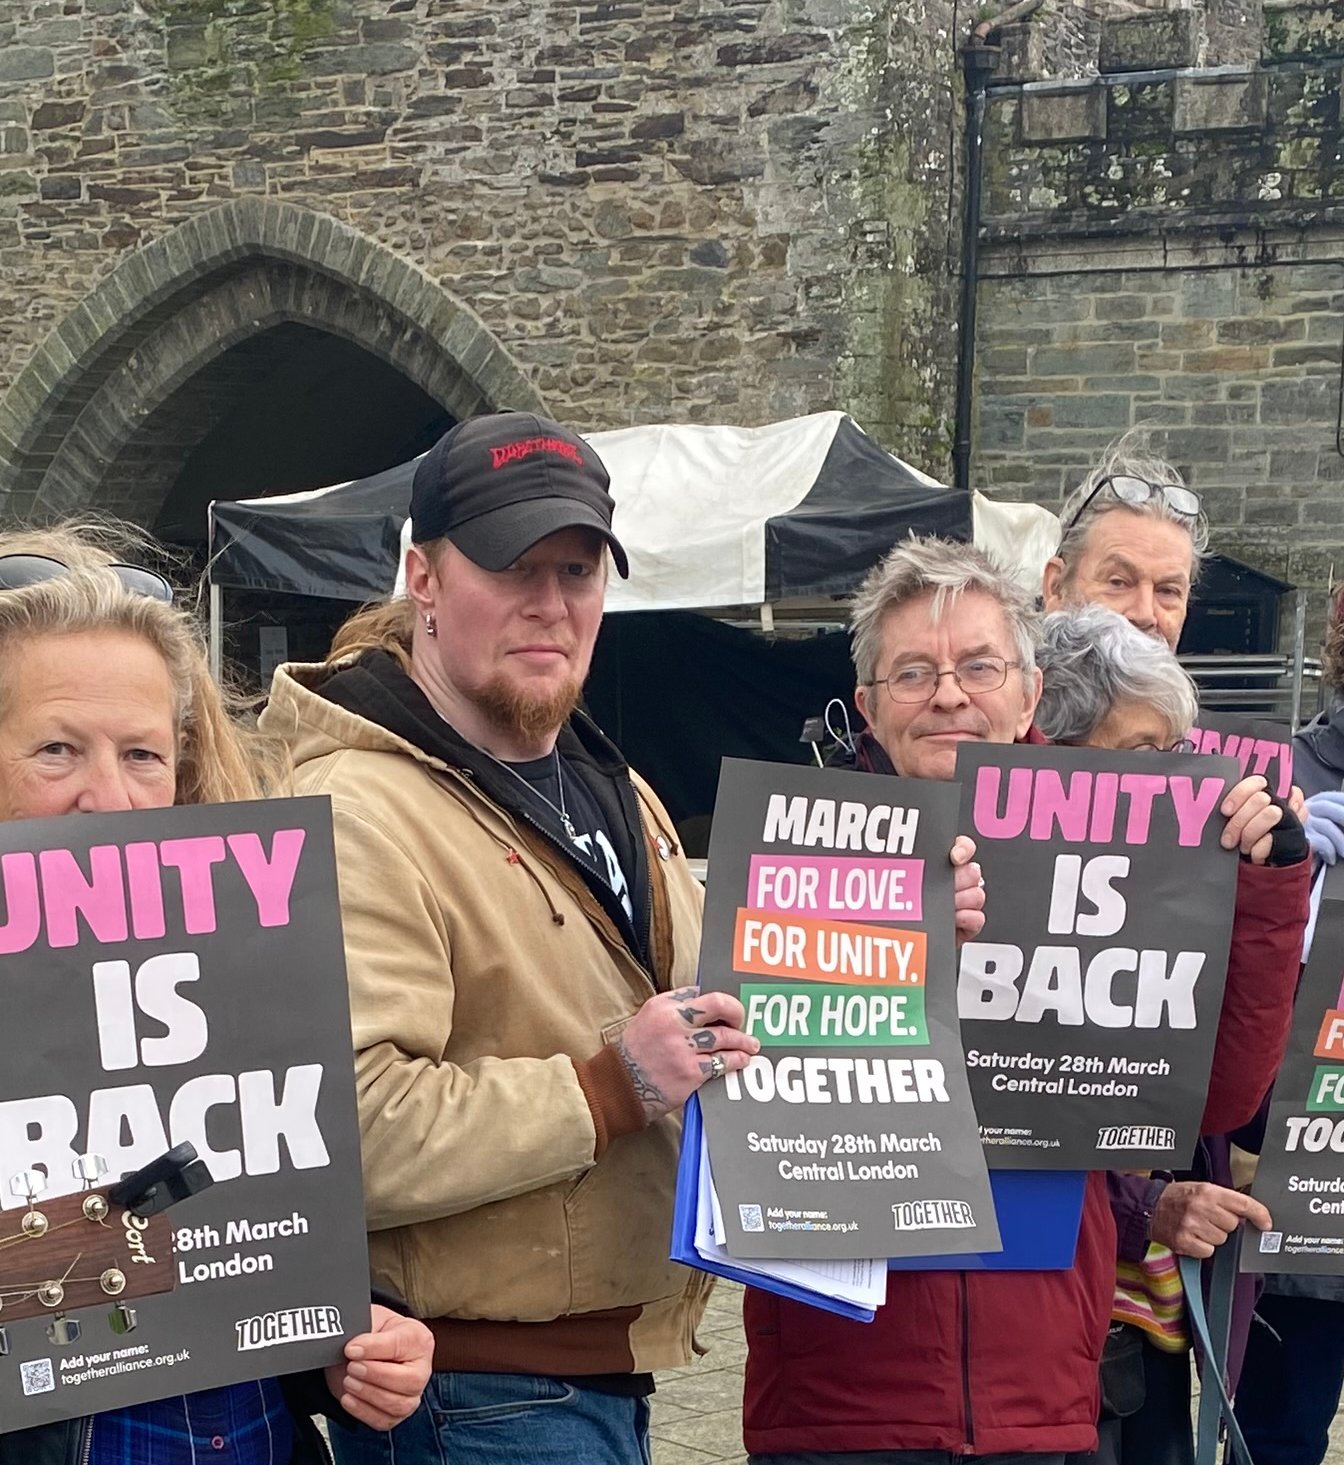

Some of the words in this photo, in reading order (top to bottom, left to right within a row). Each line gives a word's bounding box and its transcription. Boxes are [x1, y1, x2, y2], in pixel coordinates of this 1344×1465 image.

[763, 794, 919, 855] MARCH
[973, 766, 1225, 847] UNITY
[756, 865, 820, 909] FOR
[828, 867, 913, 911] LOVE.
[1048, 854, 1130, 936] IS
[743, 919, 806, 968] FOR
[816, 929, 918, 983] UNITY.
[955, 942, 1206, 1029] BACK
[92, 952, 208, 1070] IS
[745, 994, 812, 1036] FOR
[820, 994, 917, 1036] HOPE.
[966, 1050, 1055, 1073] Saturday
[1059, 1055, 1104, 1074] 28th
[1107, 1057, 1170, 1076] March
[991, 1074, 1065, 1094] Central
[1067, 1079, 1139, 1097] London
[747, 1132, 827, 1158] Saturday
[831, 1133, 876, 1154] 28th
[880, 1133, 941, 1153] March
[1096, 1126, 1175, 1150] TOGETHER
[778, 1160, 845, 1181] Central
[848, 1160, 918, 1180] London
[171, 1225, 220, 1253] 8th
[225, 1212, 309, 1245] March
[767, 1207, 783, 1217] Add
[784, 1209, 801, 1220] your
[803, 1210, 828, 1219] name:
[892, 1200, 976, 1230] TOGETHER
[178, 1253, 274, 1284] London
[236, 1306, 344, 1350] TOGETHER
[59, 1355, 84, 1371] Add
[85, 1351, 111, 1367] your
[112, 1344, 150, 1360] name:
[61, 1349, 191, 1386] togetheralliance.org.uk
